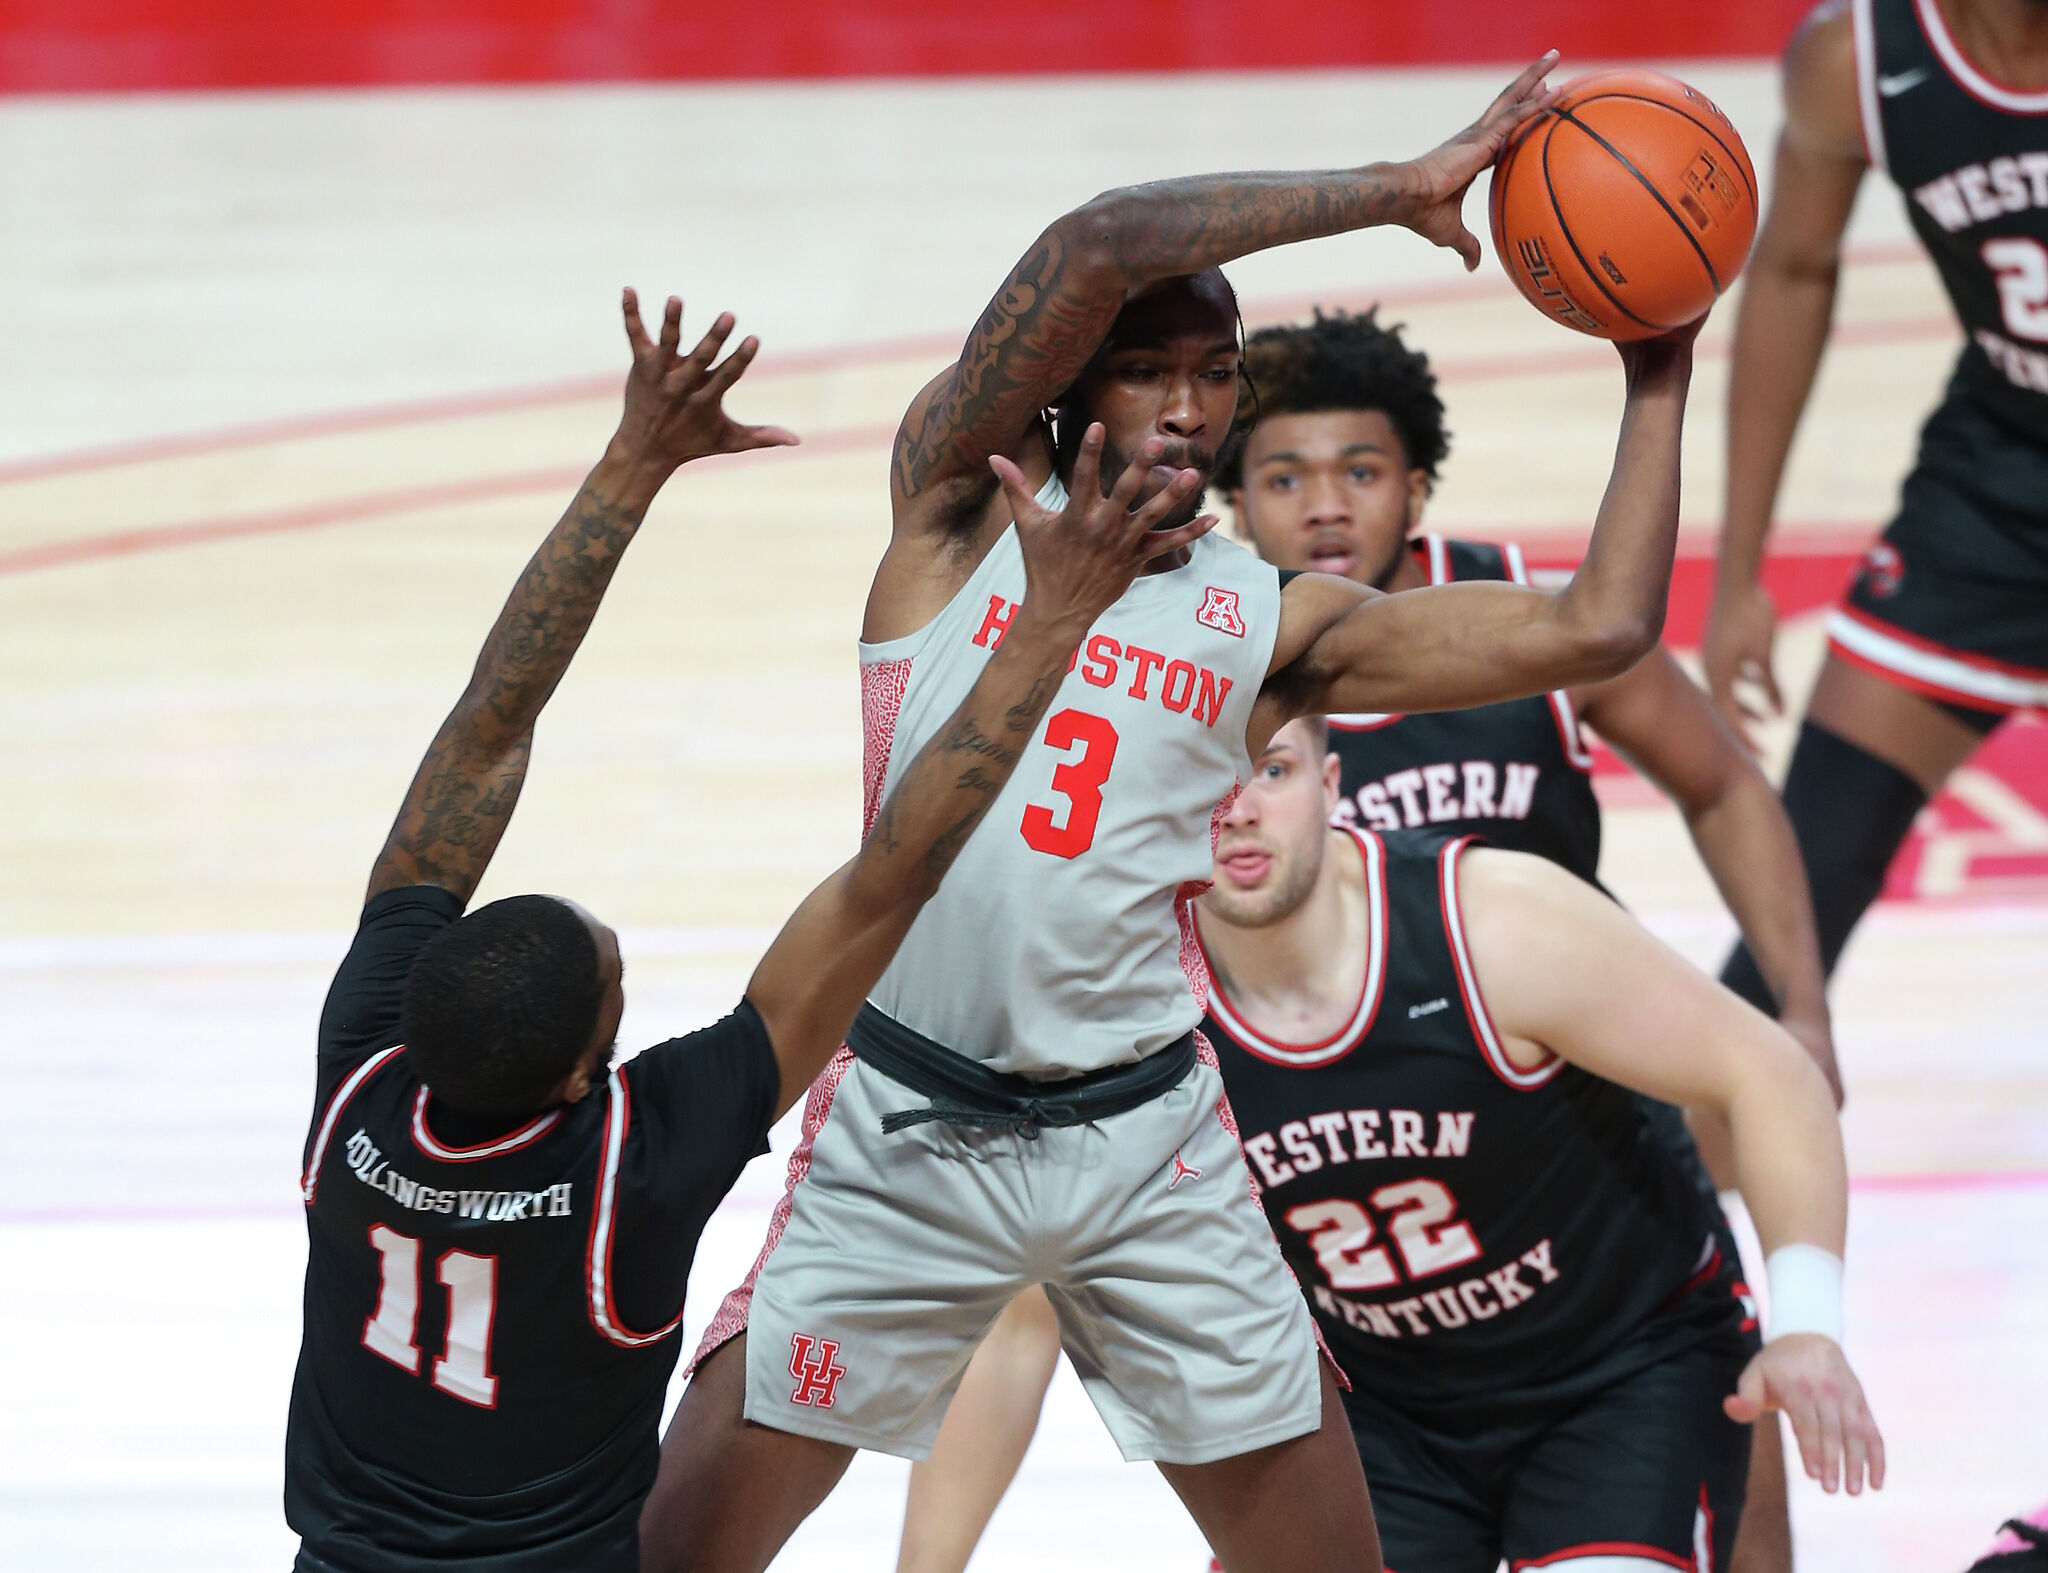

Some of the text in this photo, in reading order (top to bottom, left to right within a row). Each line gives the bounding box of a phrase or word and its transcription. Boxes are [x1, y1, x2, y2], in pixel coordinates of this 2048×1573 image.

[972, 594, 1233, 728] HSTON
[1020, 708, 1119, 860] 3
[1329, 760, 1540, 831] STERN
[1244, 1108, 1476, 1194] ESTERN
[1283, 1176, 1484, 1290] 22
[361, 1222, 498, 1409] 11
[788, 1332, 848, 1410] UH
